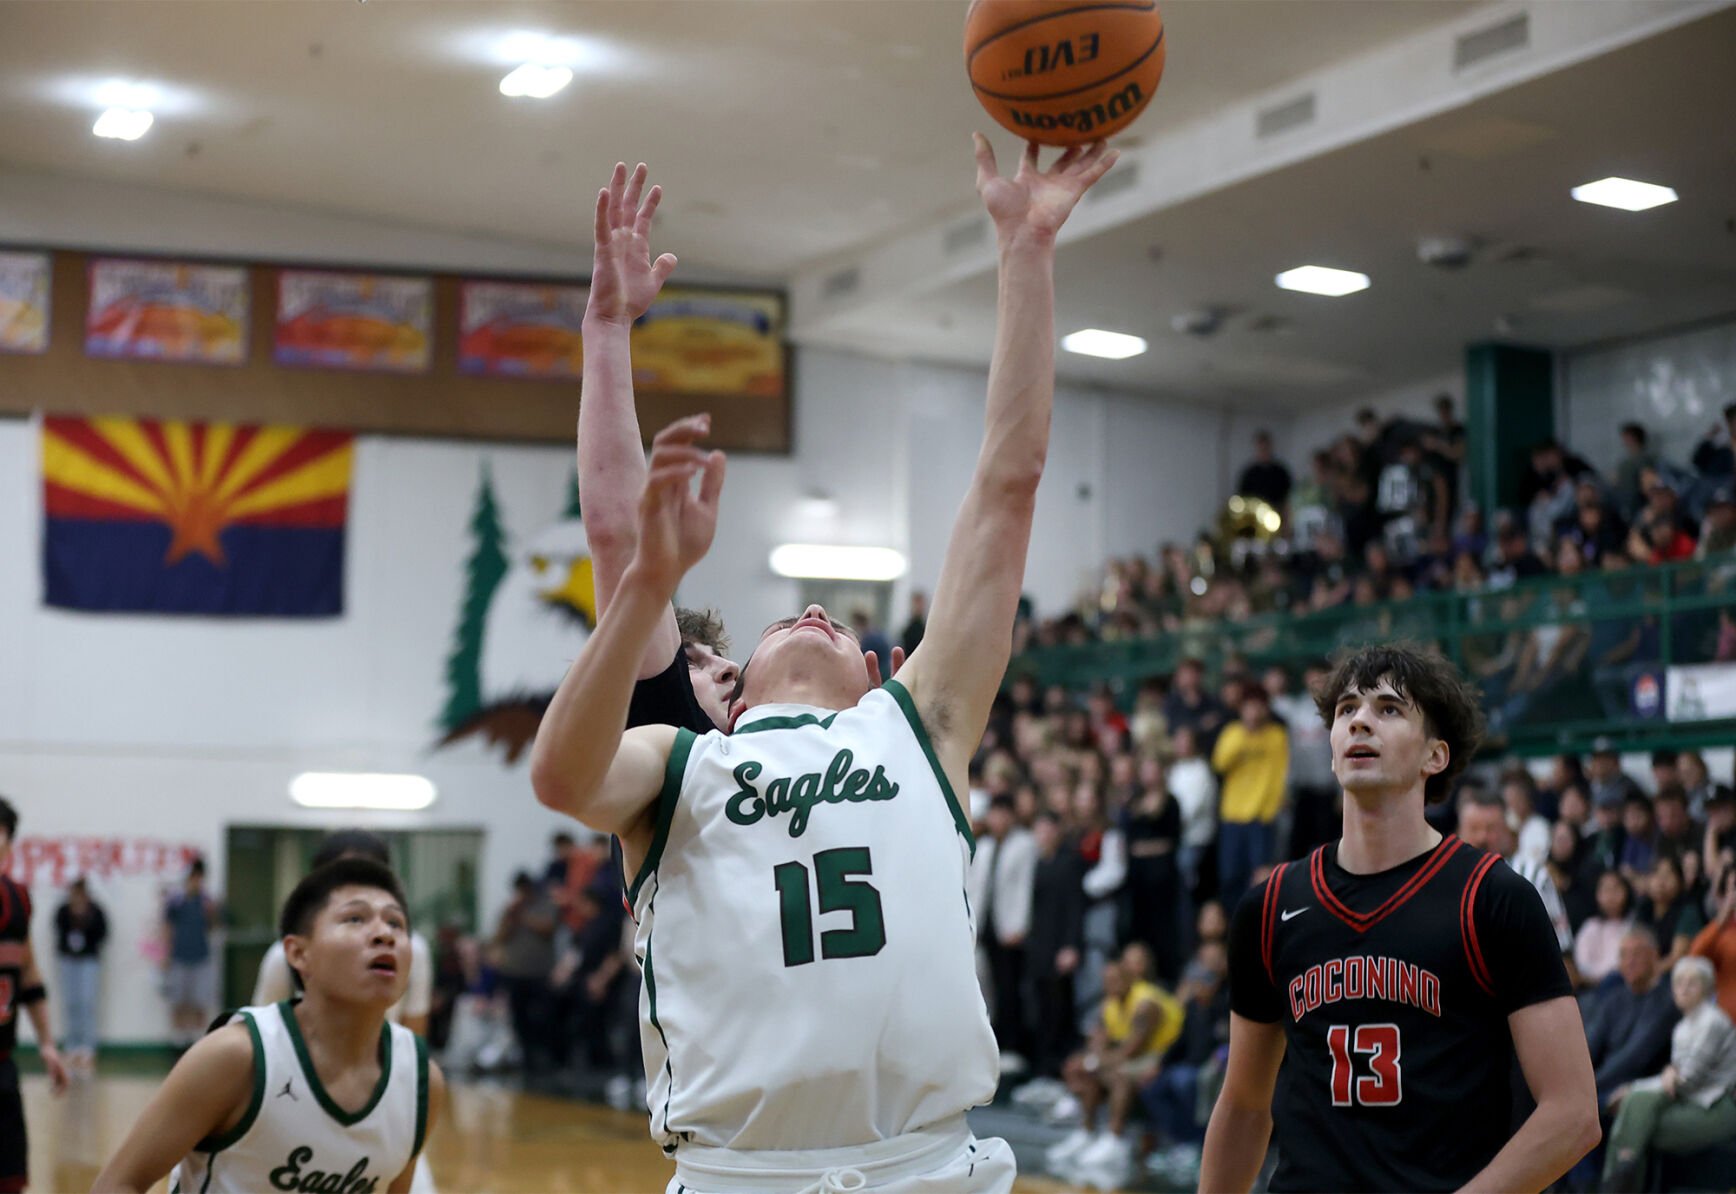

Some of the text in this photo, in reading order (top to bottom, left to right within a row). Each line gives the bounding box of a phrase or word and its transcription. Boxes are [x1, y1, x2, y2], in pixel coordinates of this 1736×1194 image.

[1024, 32, 1100, 75] EVO
[1010, 82, 1142, 132] Wilson
[725, 748, 900, 838] Eagles
[773, 846, 887, 967] 15
[1288, 955, 1441, 1023] COCONINO
[1327, 1023, 1402, 1107] 13
